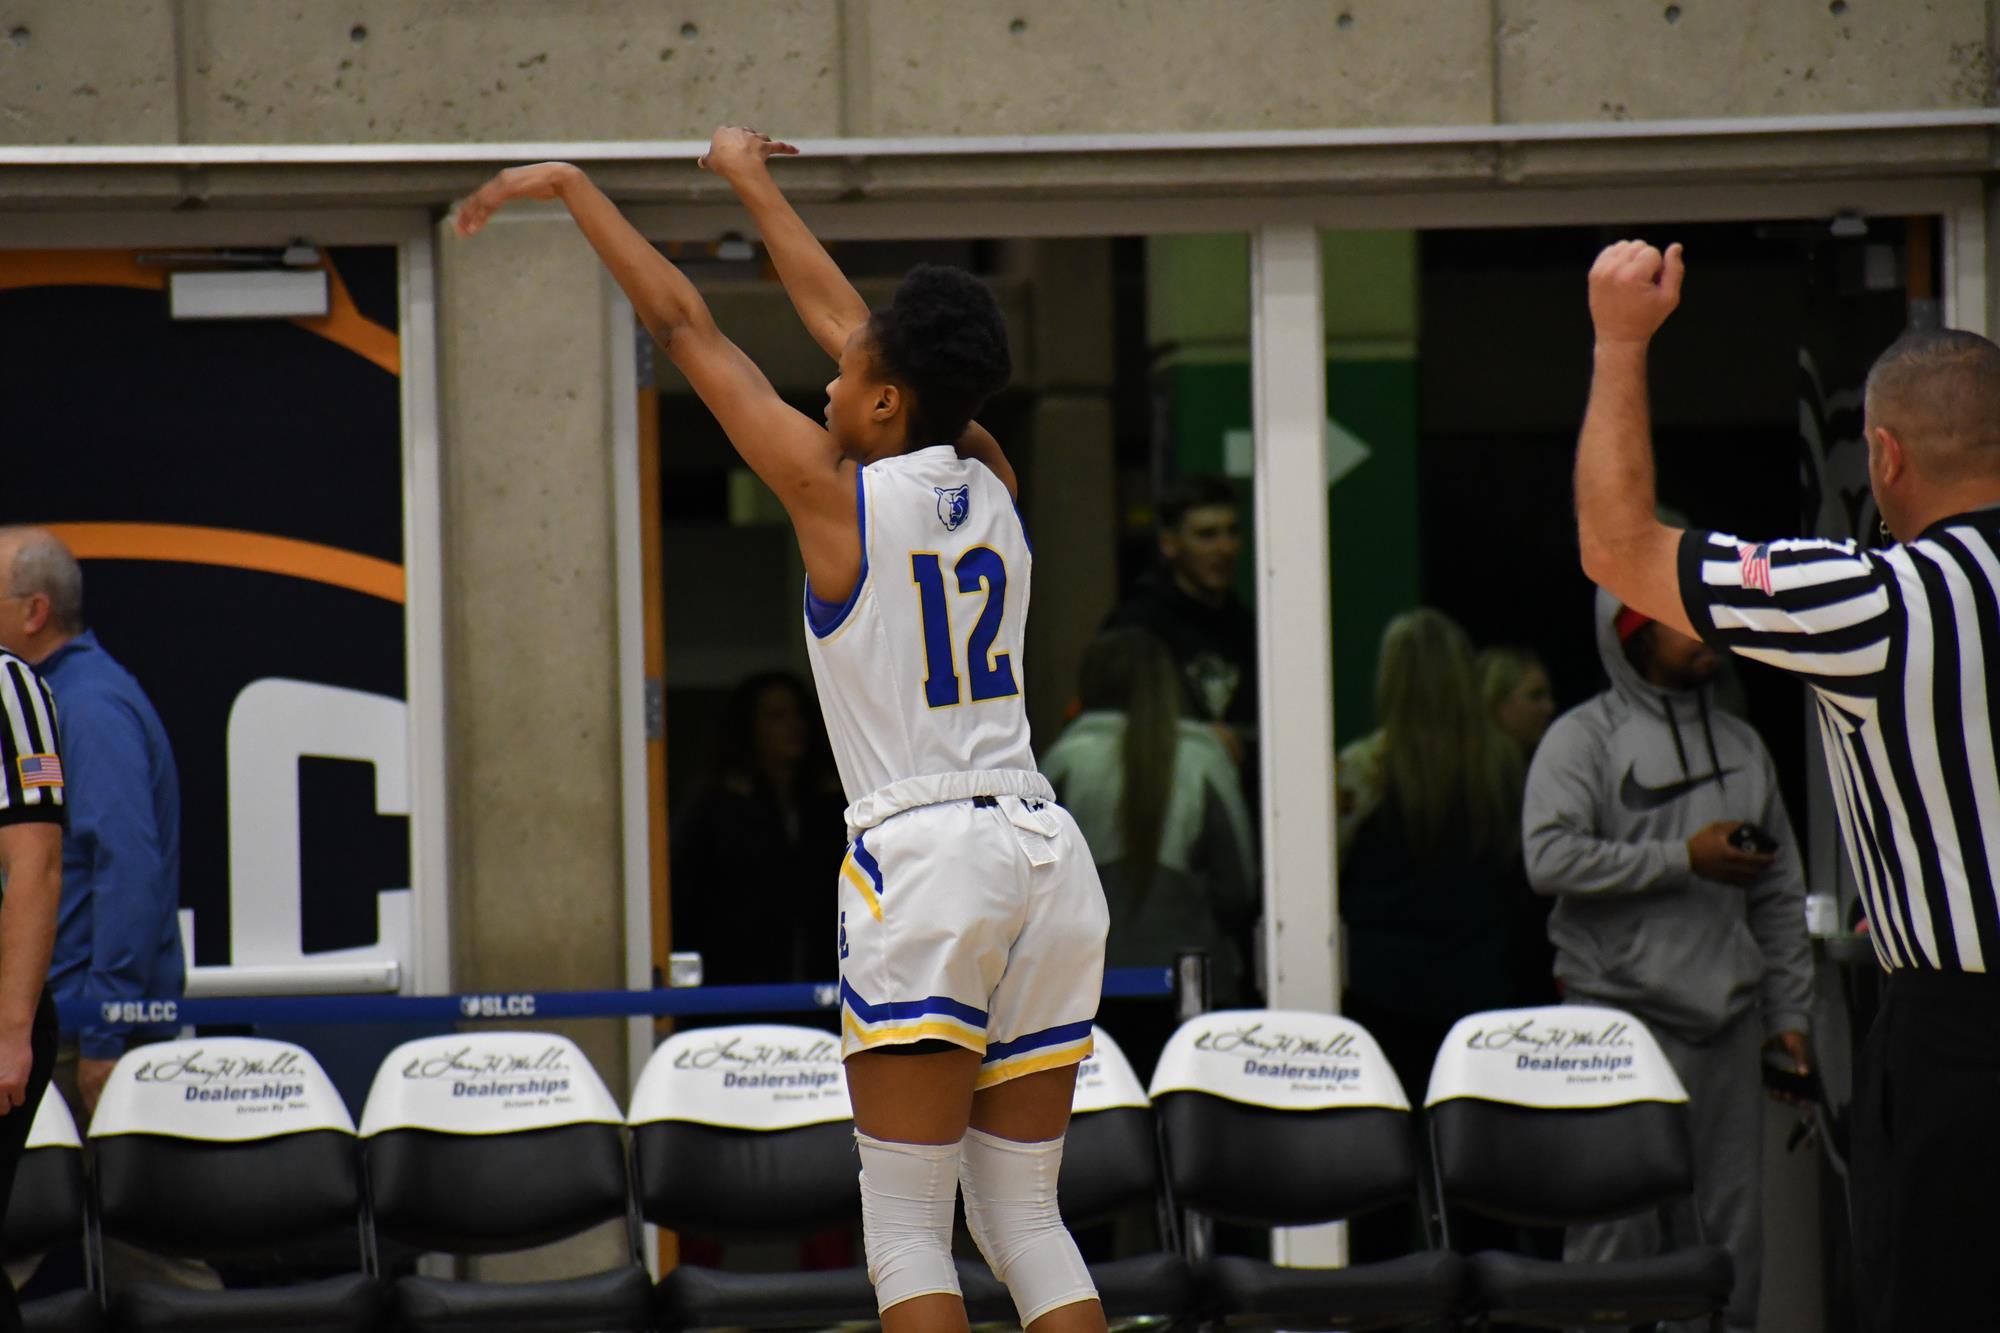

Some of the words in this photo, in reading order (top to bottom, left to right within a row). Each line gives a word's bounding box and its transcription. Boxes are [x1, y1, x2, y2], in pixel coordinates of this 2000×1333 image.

[911, 545, 1020, 709] 12
[123, 1001, 177, 1022] SLCC
[481, 995, 535, 1016] SLCC
[1243, 1059, 1360, 1082] Dealerships
[1516, 1053, 1633, 1072] Dealerships
[452, 1078, 569, 1097] Dealerships
[723, 1069, 838, 1088] Dealerships
[185, 1082, 304, 1102] Dealerships
